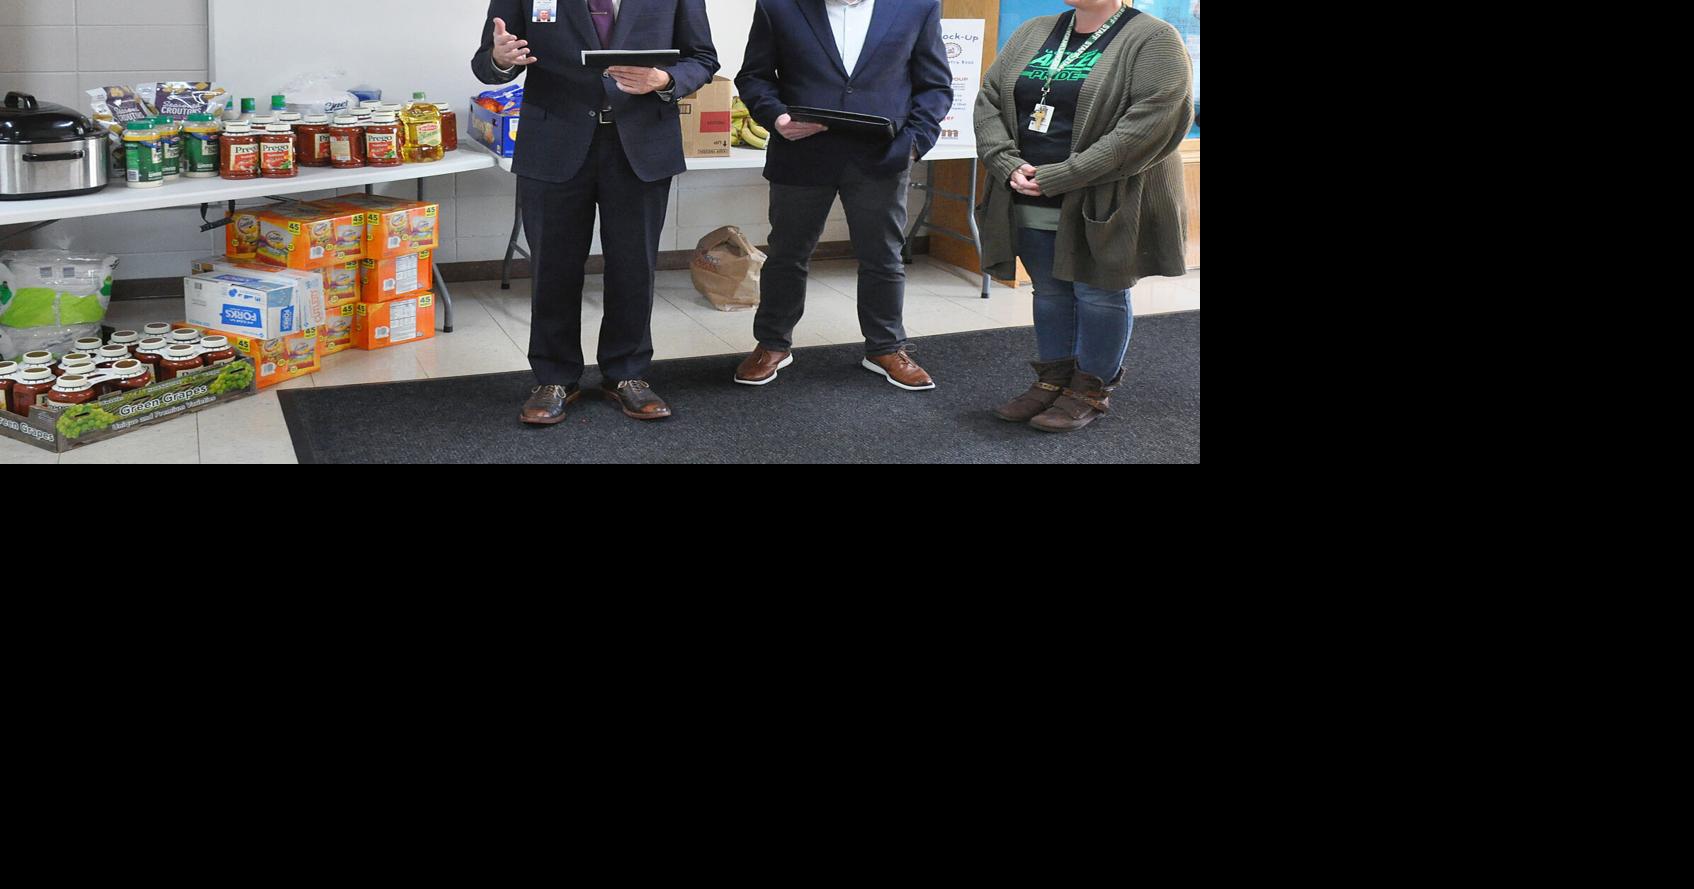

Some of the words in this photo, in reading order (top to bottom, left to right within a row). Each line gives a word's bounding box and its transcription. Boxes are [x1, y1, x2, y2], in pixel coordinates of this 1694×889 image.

[942, 33, 979, 43] ock-Up
[1029, 69, 1079, 80] PRDE
[367, 135, 392, 143] Prego
[235, 145, 258, 153] Preg
[262, 144, 289, 153] Prego
[224, 309, 257, 322] FORKS
[118, 398, 160, 416] Green
[162, 385, 208, 404] Grapes
[112, 417, 139, 431] Unique
[140, 412, 153, 422] and
[154, 404, 187, 418] Premium
[187, 396, 216, 409] Varieties
[0, 416, 19, 431] reen
[20, 422, 55, 442] Grapes
